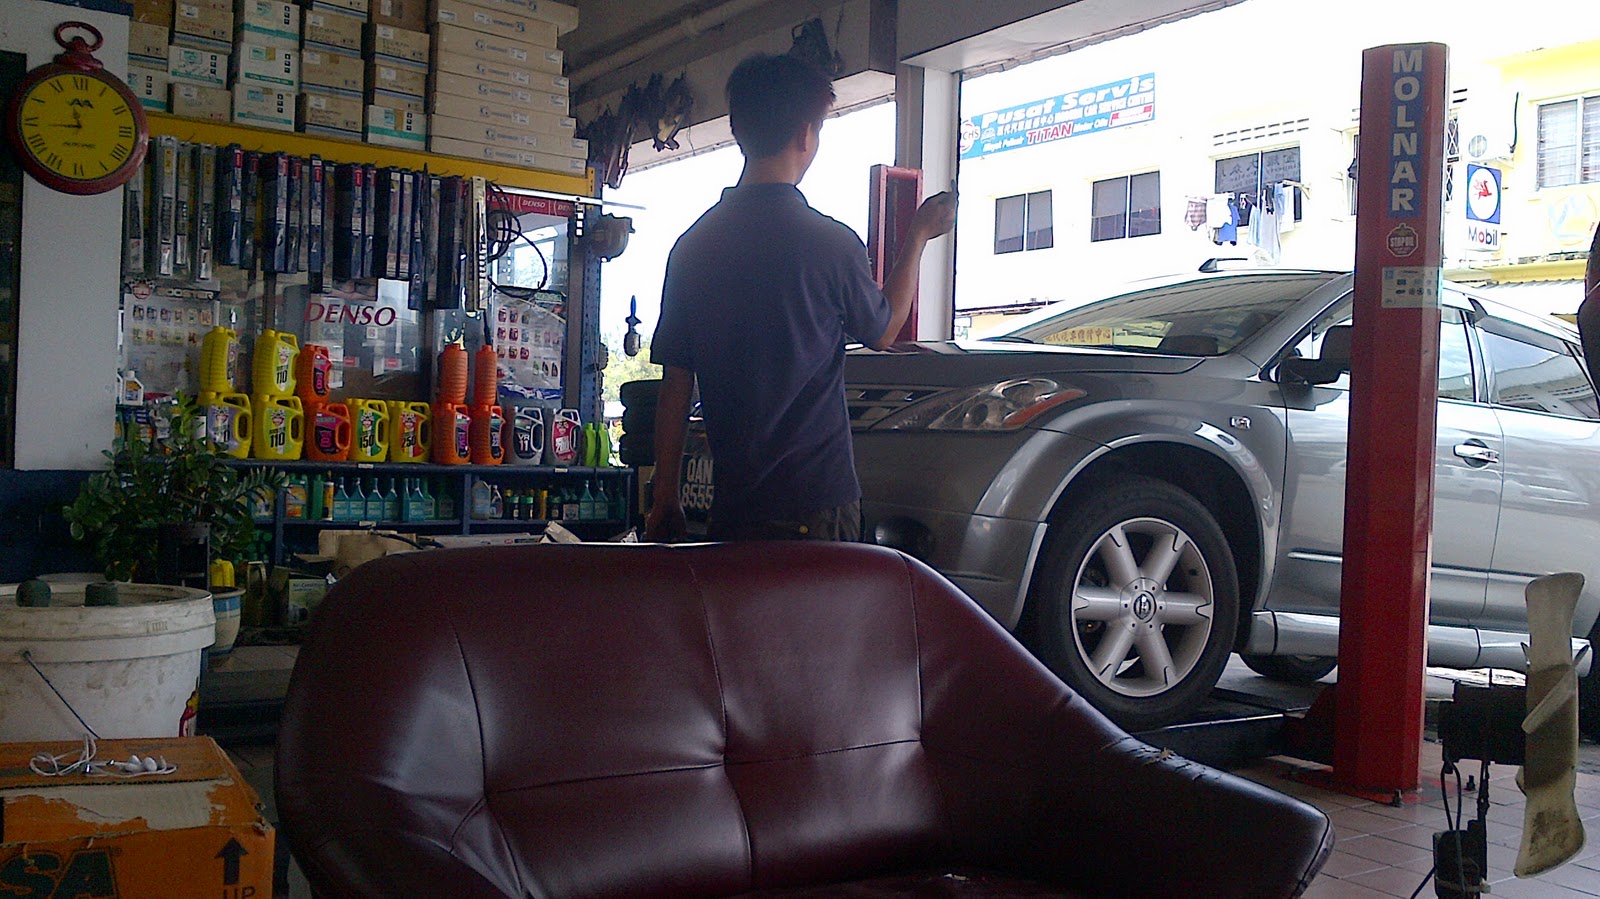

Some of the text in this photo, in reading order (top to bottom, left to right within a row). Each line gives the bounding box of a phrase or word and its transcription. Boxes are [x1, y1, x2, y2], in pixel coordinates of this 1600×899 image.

[981, 97, 1056, 129] Pusat
[962, 128, 979, 140] CHS
[1028, 123, 1073, 144] TITAN
[1391, 49, 1422, 211] MOLNAR
[522, 199, 546, 208] DENSO
[1468, 225, 1497, 246] Mobil
[304, 302, 396, 326] DENSO
[270, 432, 286, 448] 110
[359, 434, 375, 449] 150
[401, 435, 416, 448] 250
[519, 440, 529, 451] 11
[681, 483, 715, 510] 8555
[223, 885, 256, 899] UP
